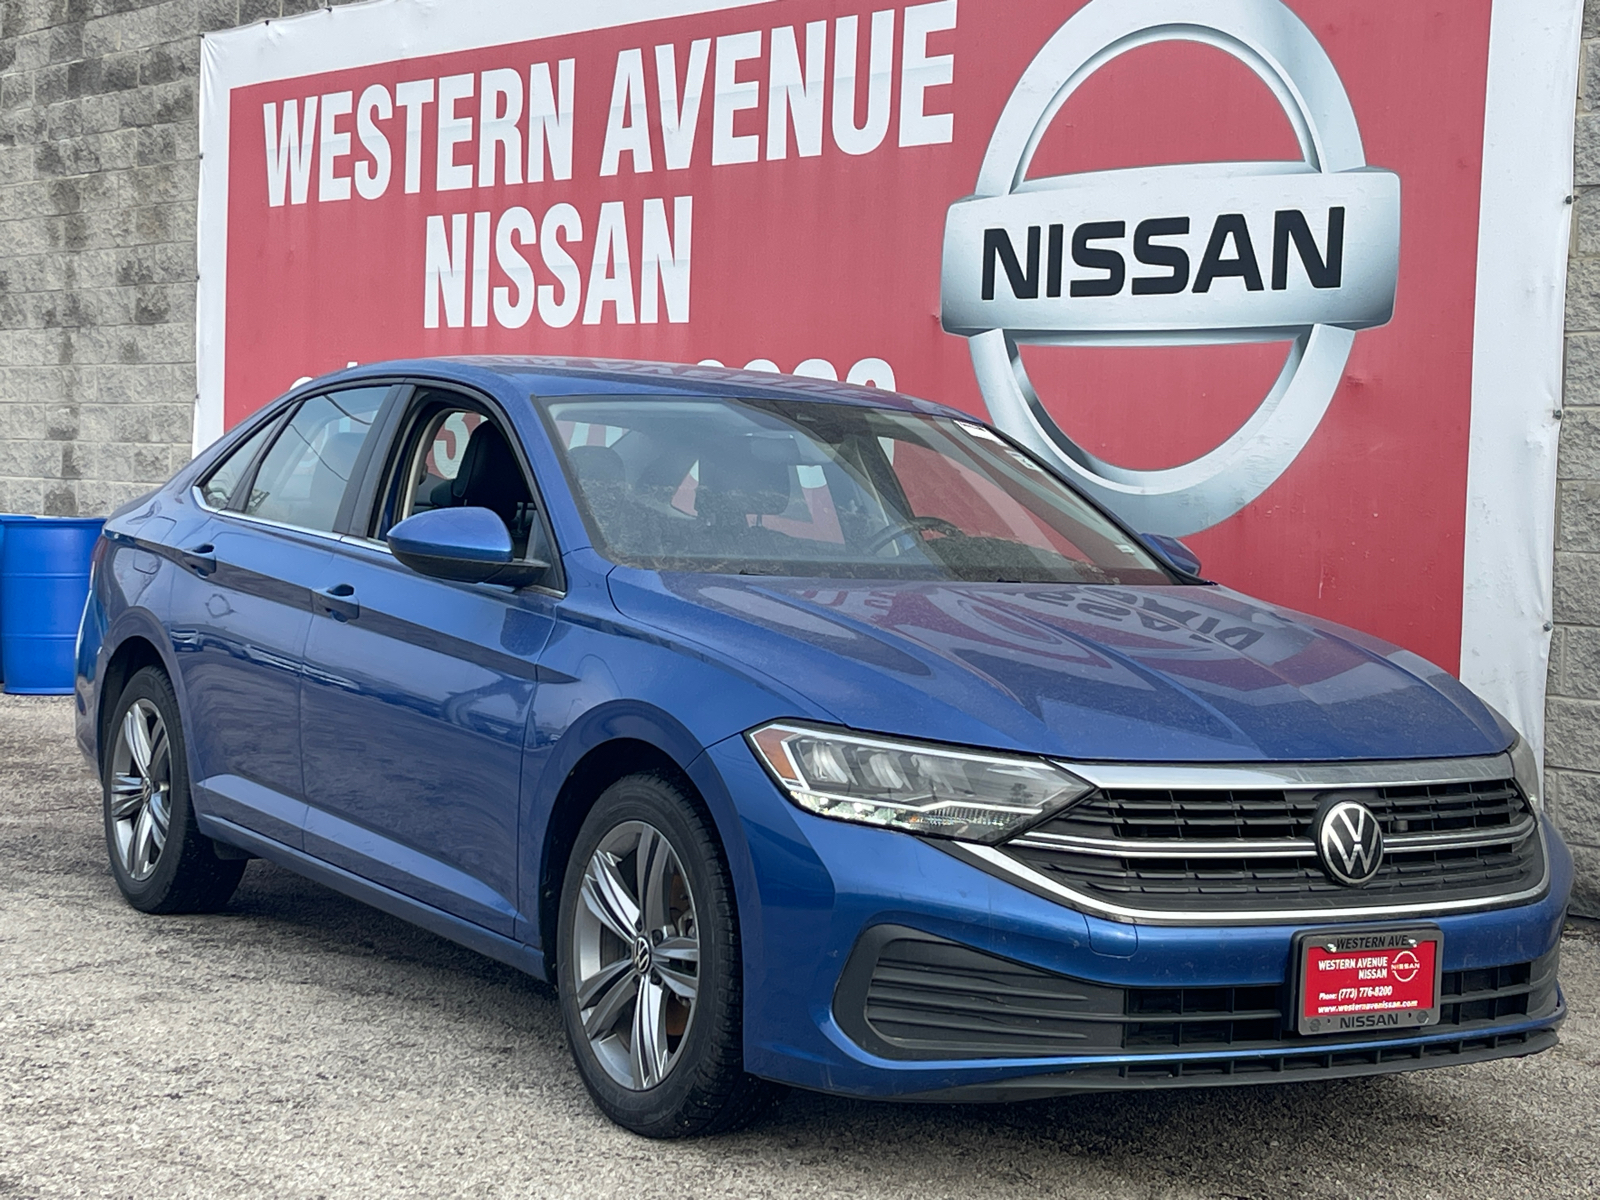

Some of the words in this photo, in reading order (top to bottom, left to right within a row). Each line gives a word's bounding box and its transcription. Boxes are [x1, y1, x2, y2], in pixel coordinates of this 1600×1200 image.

[263, 58, 576, 208] WESTERN
[600, 0, 958, 177] AVENUE
[981, 206, 1345, 300] NISSAN
[424, 195, 693, 329] NISSAN
[1335, 937, 1386, 950] WESTERN
[1318, 959, 1356, 971] WESTERN
[1357, 957, 1388, 969] AVENUE
[1358, 968, 1388, 980] NISSAN
[1319, 992, 1337, 1000] Phone:
[1338, 988, 1358, 1001] (773)
[1340, 1013, 1399, 1029] NISSAN
